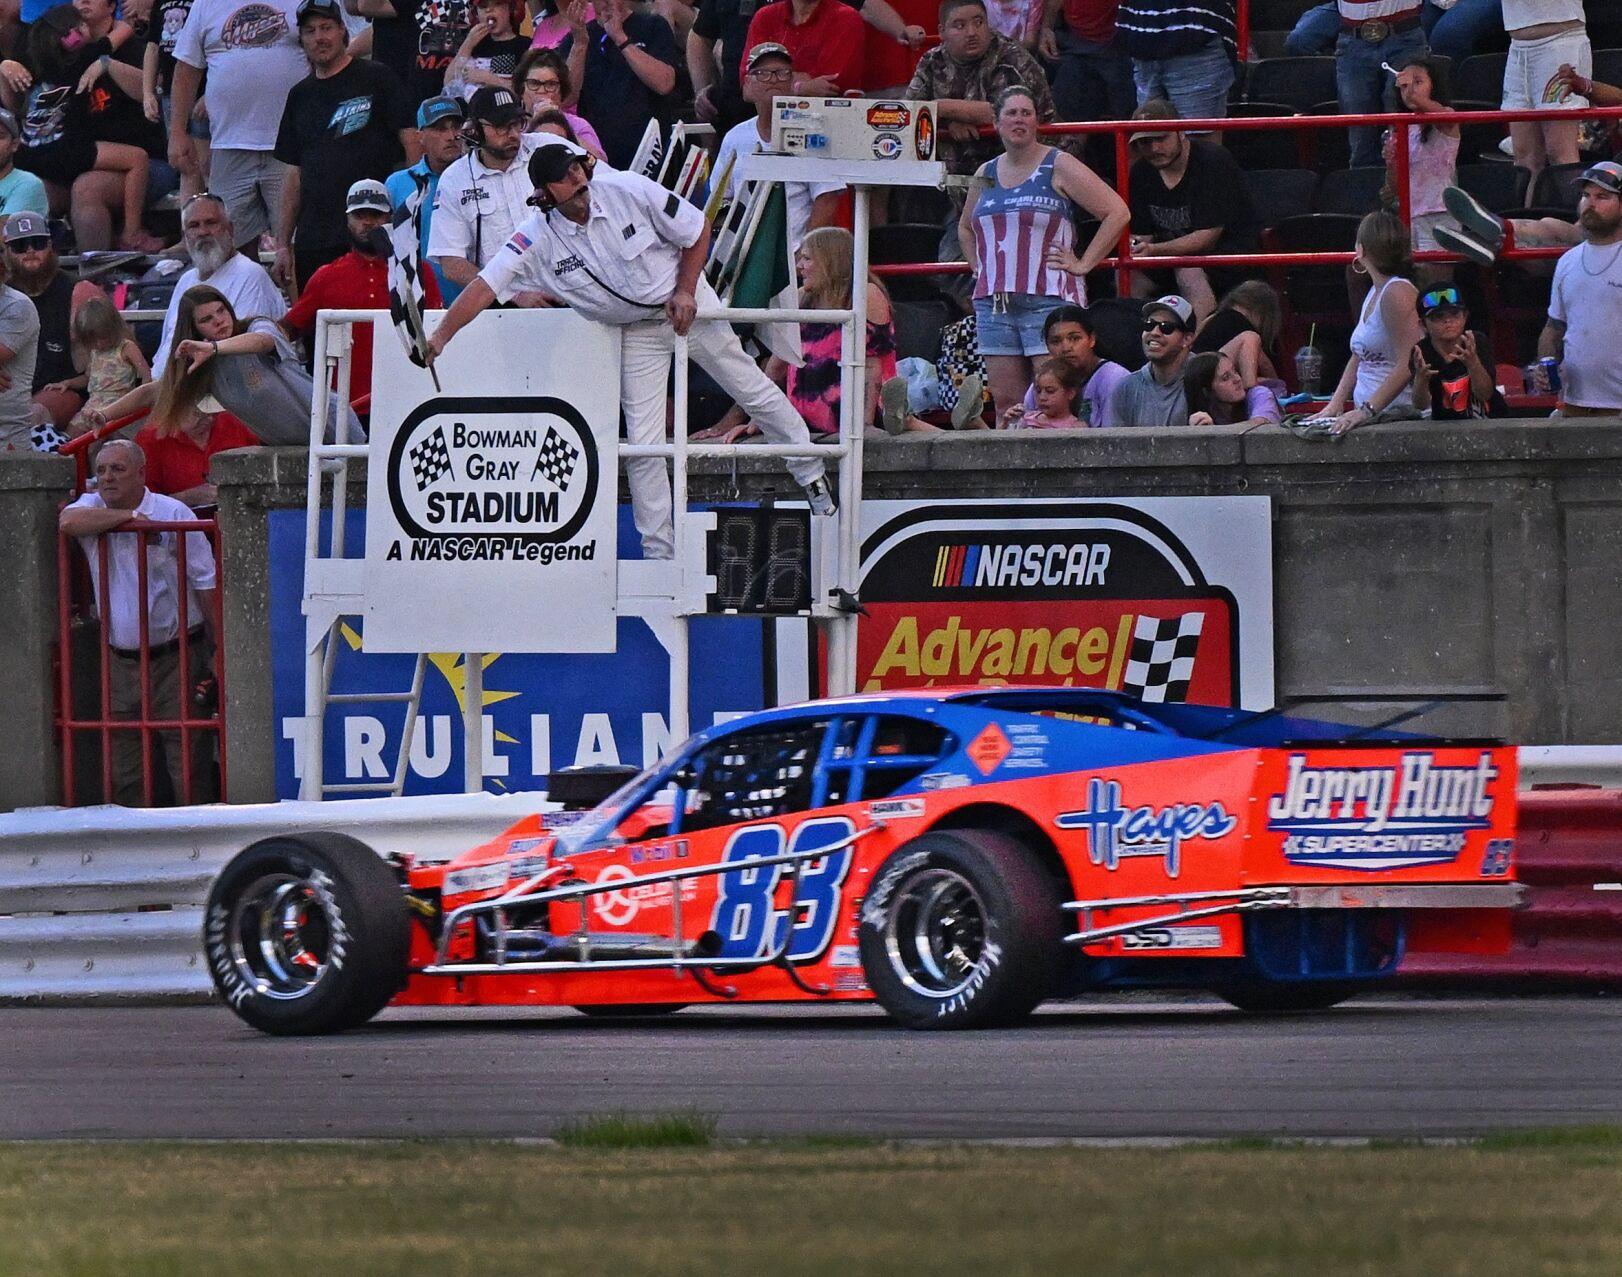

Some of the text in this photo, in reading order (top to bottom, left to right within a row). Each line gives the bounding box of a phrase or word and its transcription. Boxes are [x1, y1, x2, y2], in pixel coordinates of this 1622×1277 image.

[460, 192, 490, 206] OFFICIAL
[462, 186, 484, 196] TRACK
[1003, 195, 1060, 208] CHARLOTTE
[554, 260, 586, 276] OFFICIAL
[556, 254, 578, 267] TRACK
[426, 491, 559, 524] STADIUM
[386, 538, 597, 566] A NASCAR Legend
[975, 544, 1112, 587] NASCAR
[871, 615, 1110, 677] Advance
[1269, 752, 1498, 832] Jerry Hunt
[1055, 778, 1238, 878] Hayes
[1302, 836, 1449, 854] SUPERCENTER
